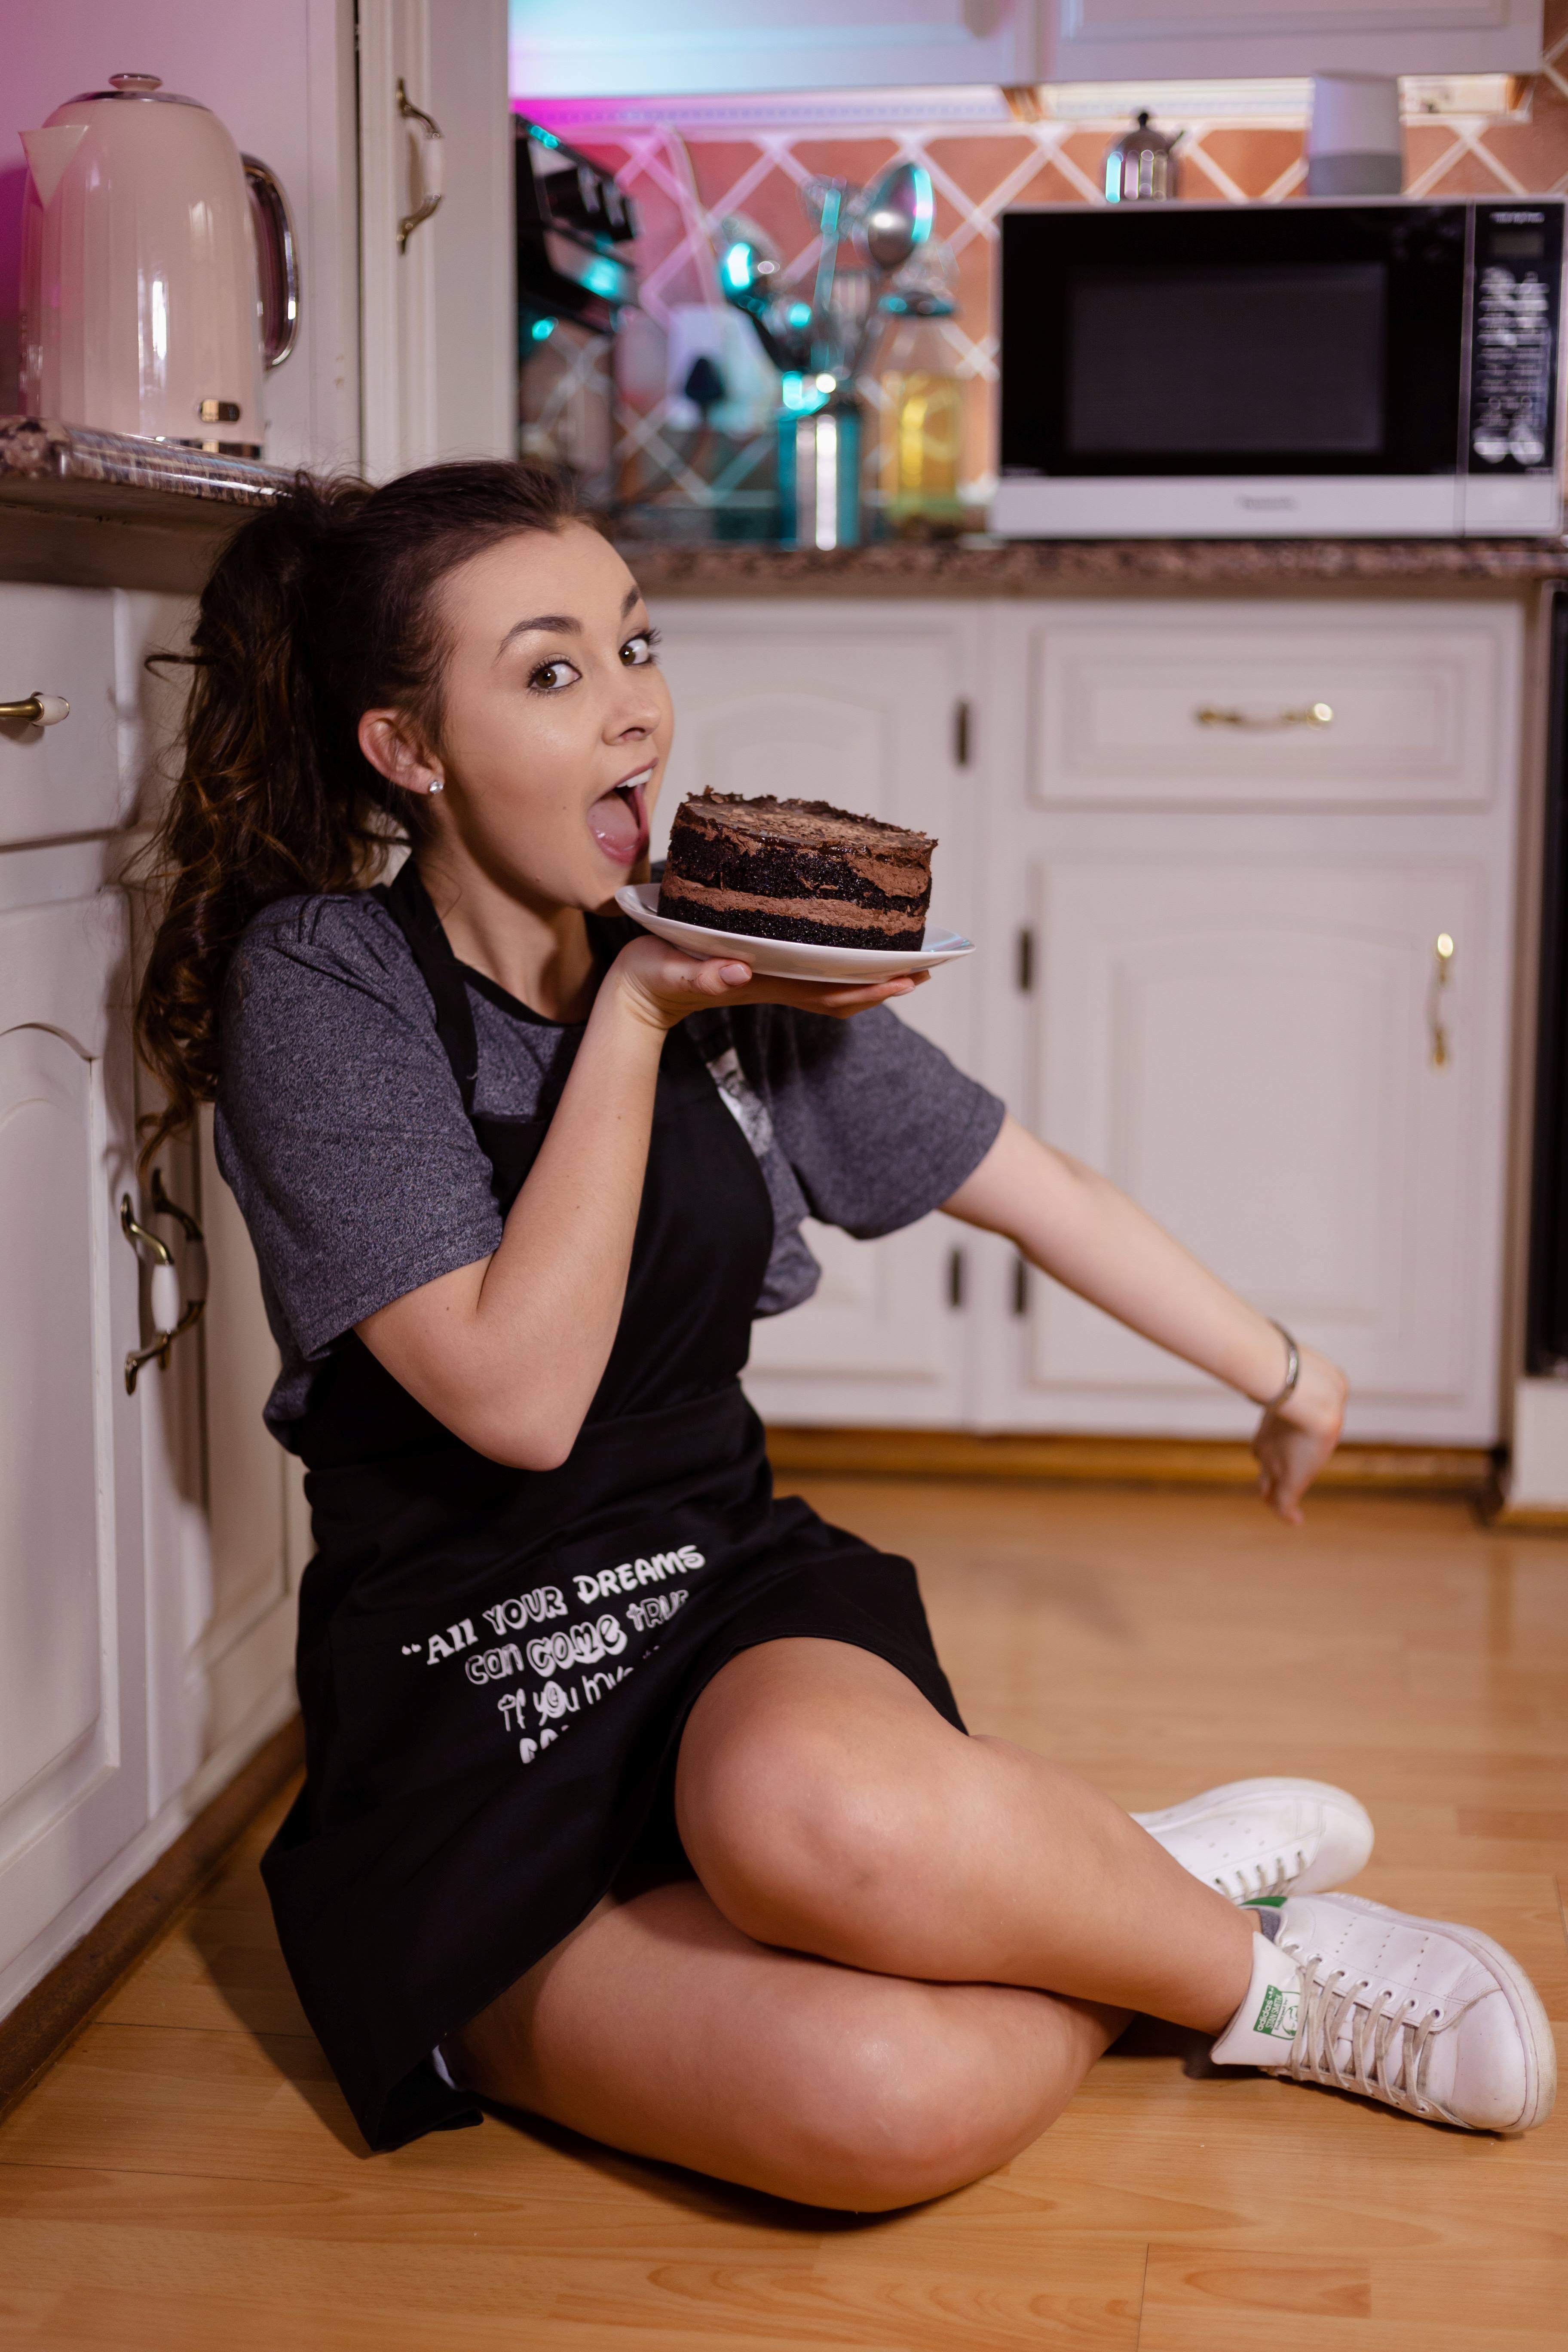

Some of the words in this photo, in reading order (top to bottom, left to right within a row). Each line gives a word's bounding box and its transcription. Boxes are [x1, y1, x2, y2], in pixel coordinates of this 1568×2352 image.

[482, 1586, 568, 1636] YOUR
[572, 1544, 706, 1605] DREAMS
[465, 1643, 525, 1685] can
[1257, 1999, 1273, 2031] adidas
[1265, 2013, 1277, 2029] STAN
[1271, 1994, 1282, 2015] SMITH
